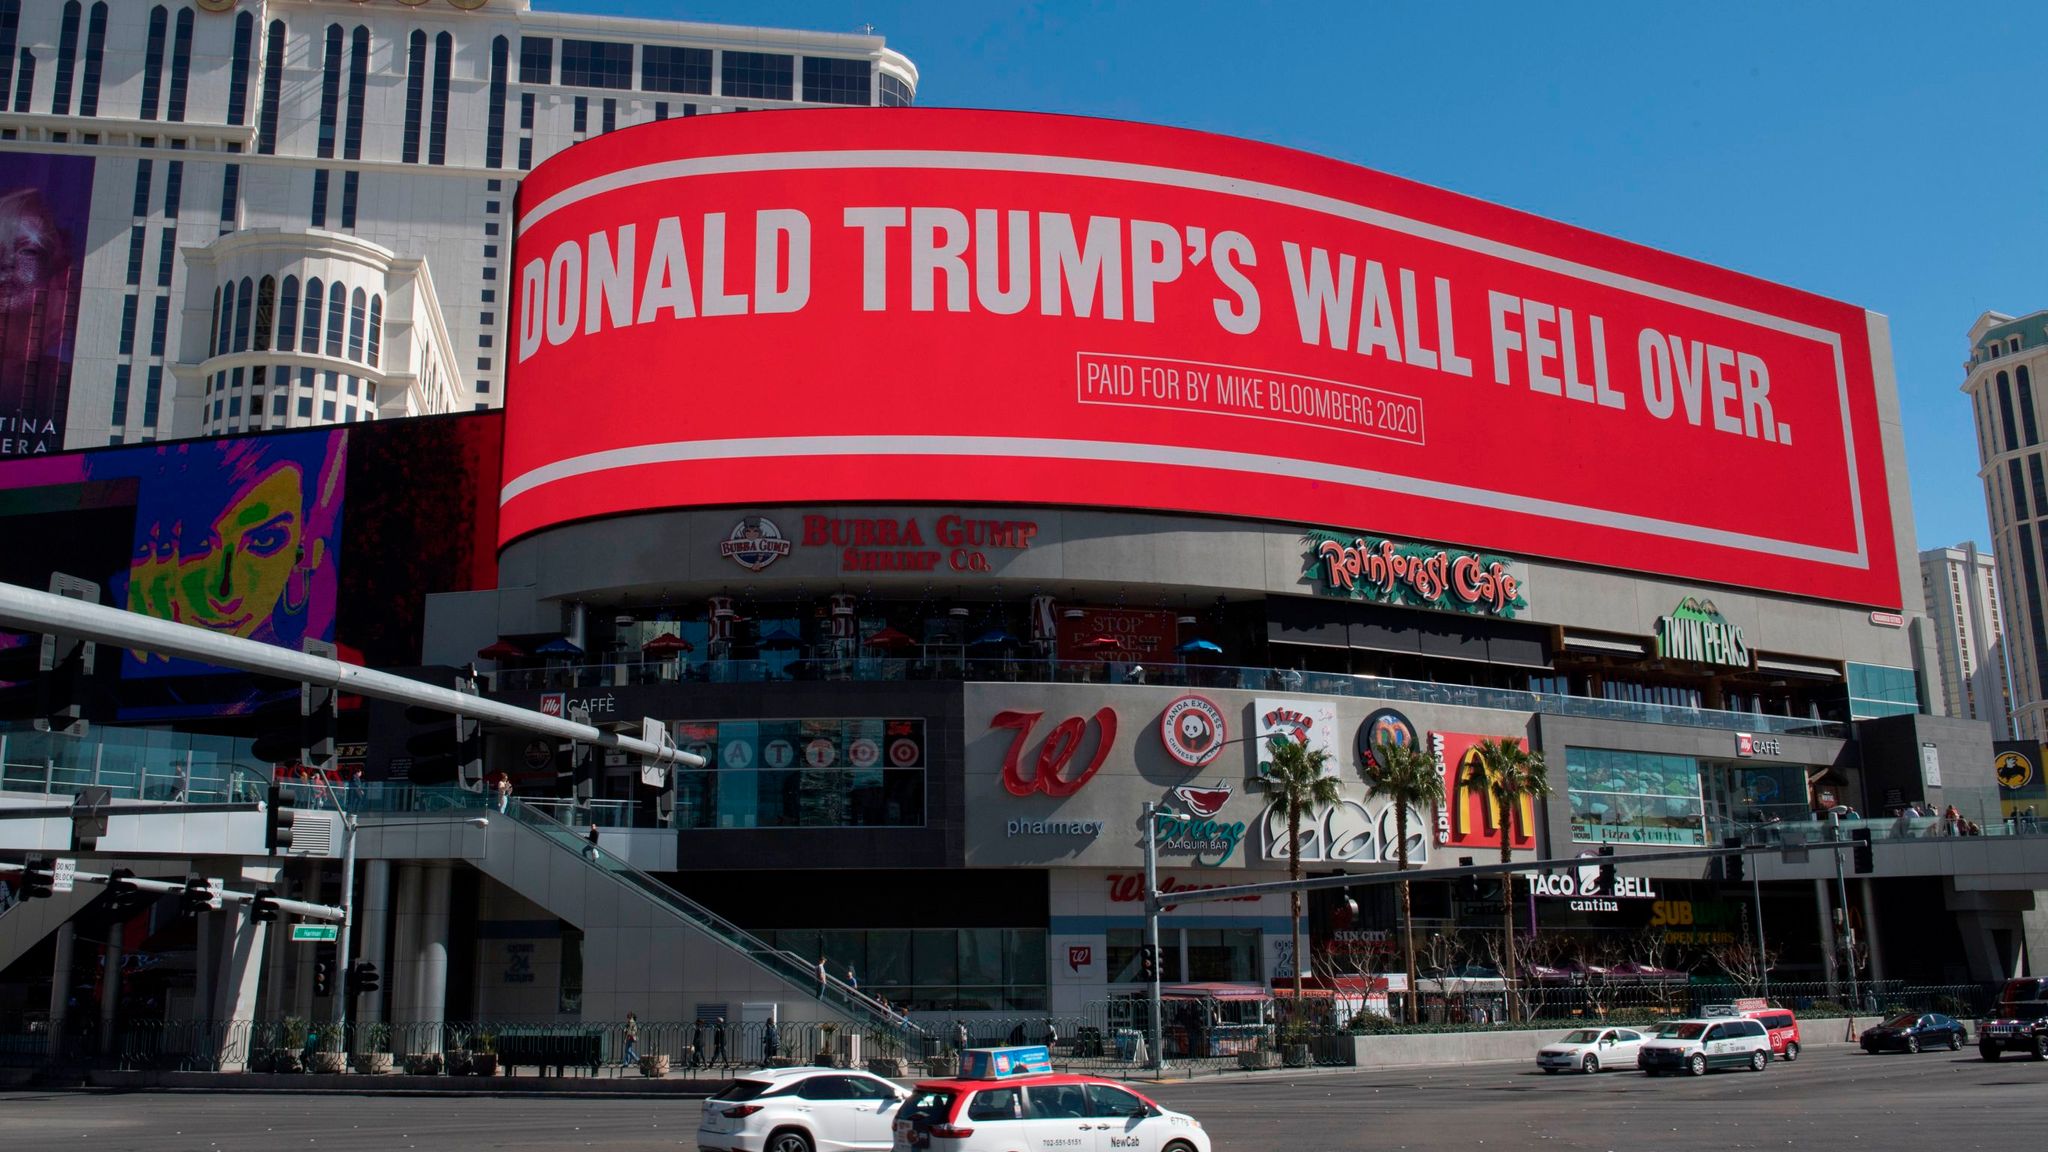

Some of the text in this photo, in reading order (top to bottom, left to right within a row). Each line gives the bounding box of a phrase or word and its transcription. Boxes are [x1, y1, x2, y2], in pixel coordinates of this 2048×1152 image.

[518, 207, 1792, 446] DONALD TRUMP'S WALL FELL OVER.
[1087, 362, 1417, 434] PAID FOR BY MIKE BLOOMBERG 2020
[801, 514, 1039, 550] BUBBA GUMP
[721, 538, 789, 556] BUBBA GUMP
[842, 548, 942, 571] SHRIMP
[1319, 539, 1518, 613] Rainforest Cafe
[1093, 616, 1144, 633] STOP
[1662, 616, 1750, 668] TWIN PEAKS
[543, 693, 615, 714] illy CAFFÈ
[1167, 700, 1223, 729] PANDA EXPRESS
[1168, 738, 1194, 761] CHINESE
[1752, 738, 1781, 754] CAFFÈ
[1007, 817, 1104, 838] pharmacy
[1156, 805, 1247, 867] Breeze
[1168, 839, 1228, 850] DAIQUIRI BAR
[65, 863, 75, 871] NOT
[1525, 874, 1656, 898] TACO BELL
[1570, 899, 1619, 912] cantina
[1334, 930, 1387, 942] SIN CITY
[1042, 1138, 1082, 1147] 702-551-5151
[1110, 1135, 1140, 1148] NewCab
